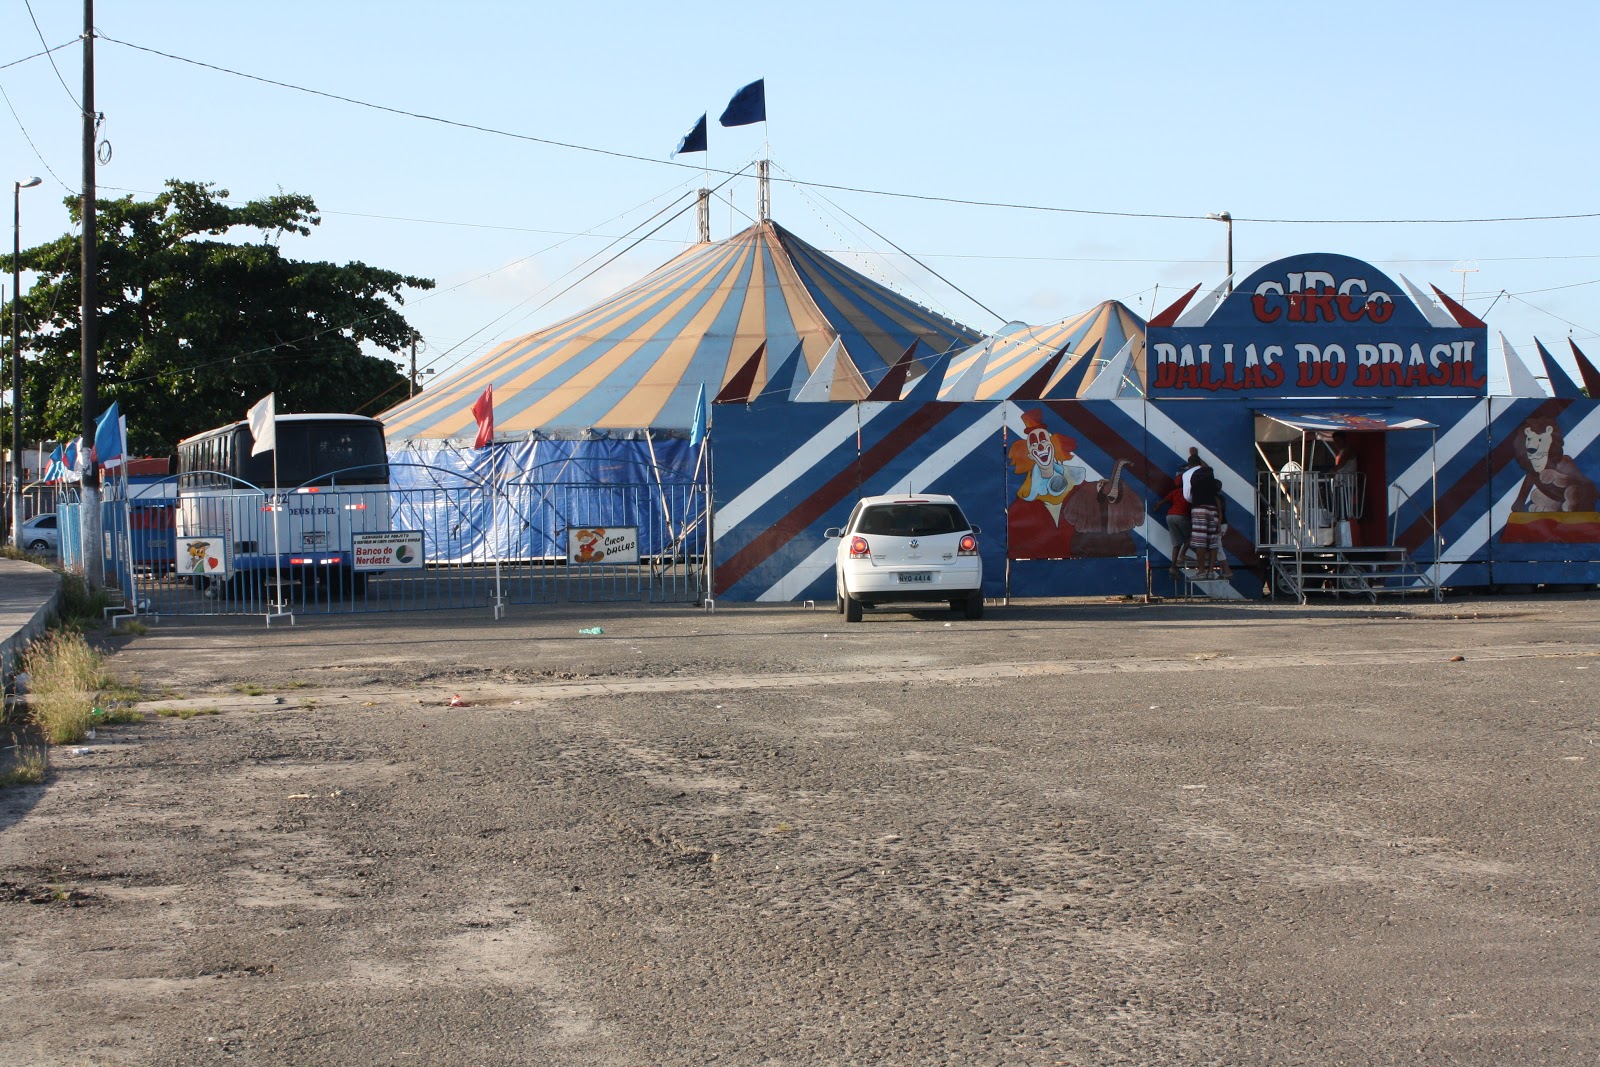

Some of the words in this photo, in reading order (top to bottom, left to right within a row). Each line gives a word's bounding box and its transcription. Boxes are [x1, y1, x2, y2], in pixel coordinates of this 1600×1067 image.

[1251, 271, 1394, 324] CIRCO
[1152, 342, 1286, 391] DALLAS
[1294, 342, 1347, 389] DO
[1354, 340, 1487, 390] BRASIL
[356, 548, 382, 556] Banco
[383, 547, 393, 555] do
[356, 556, 391, 565] Nordeste
